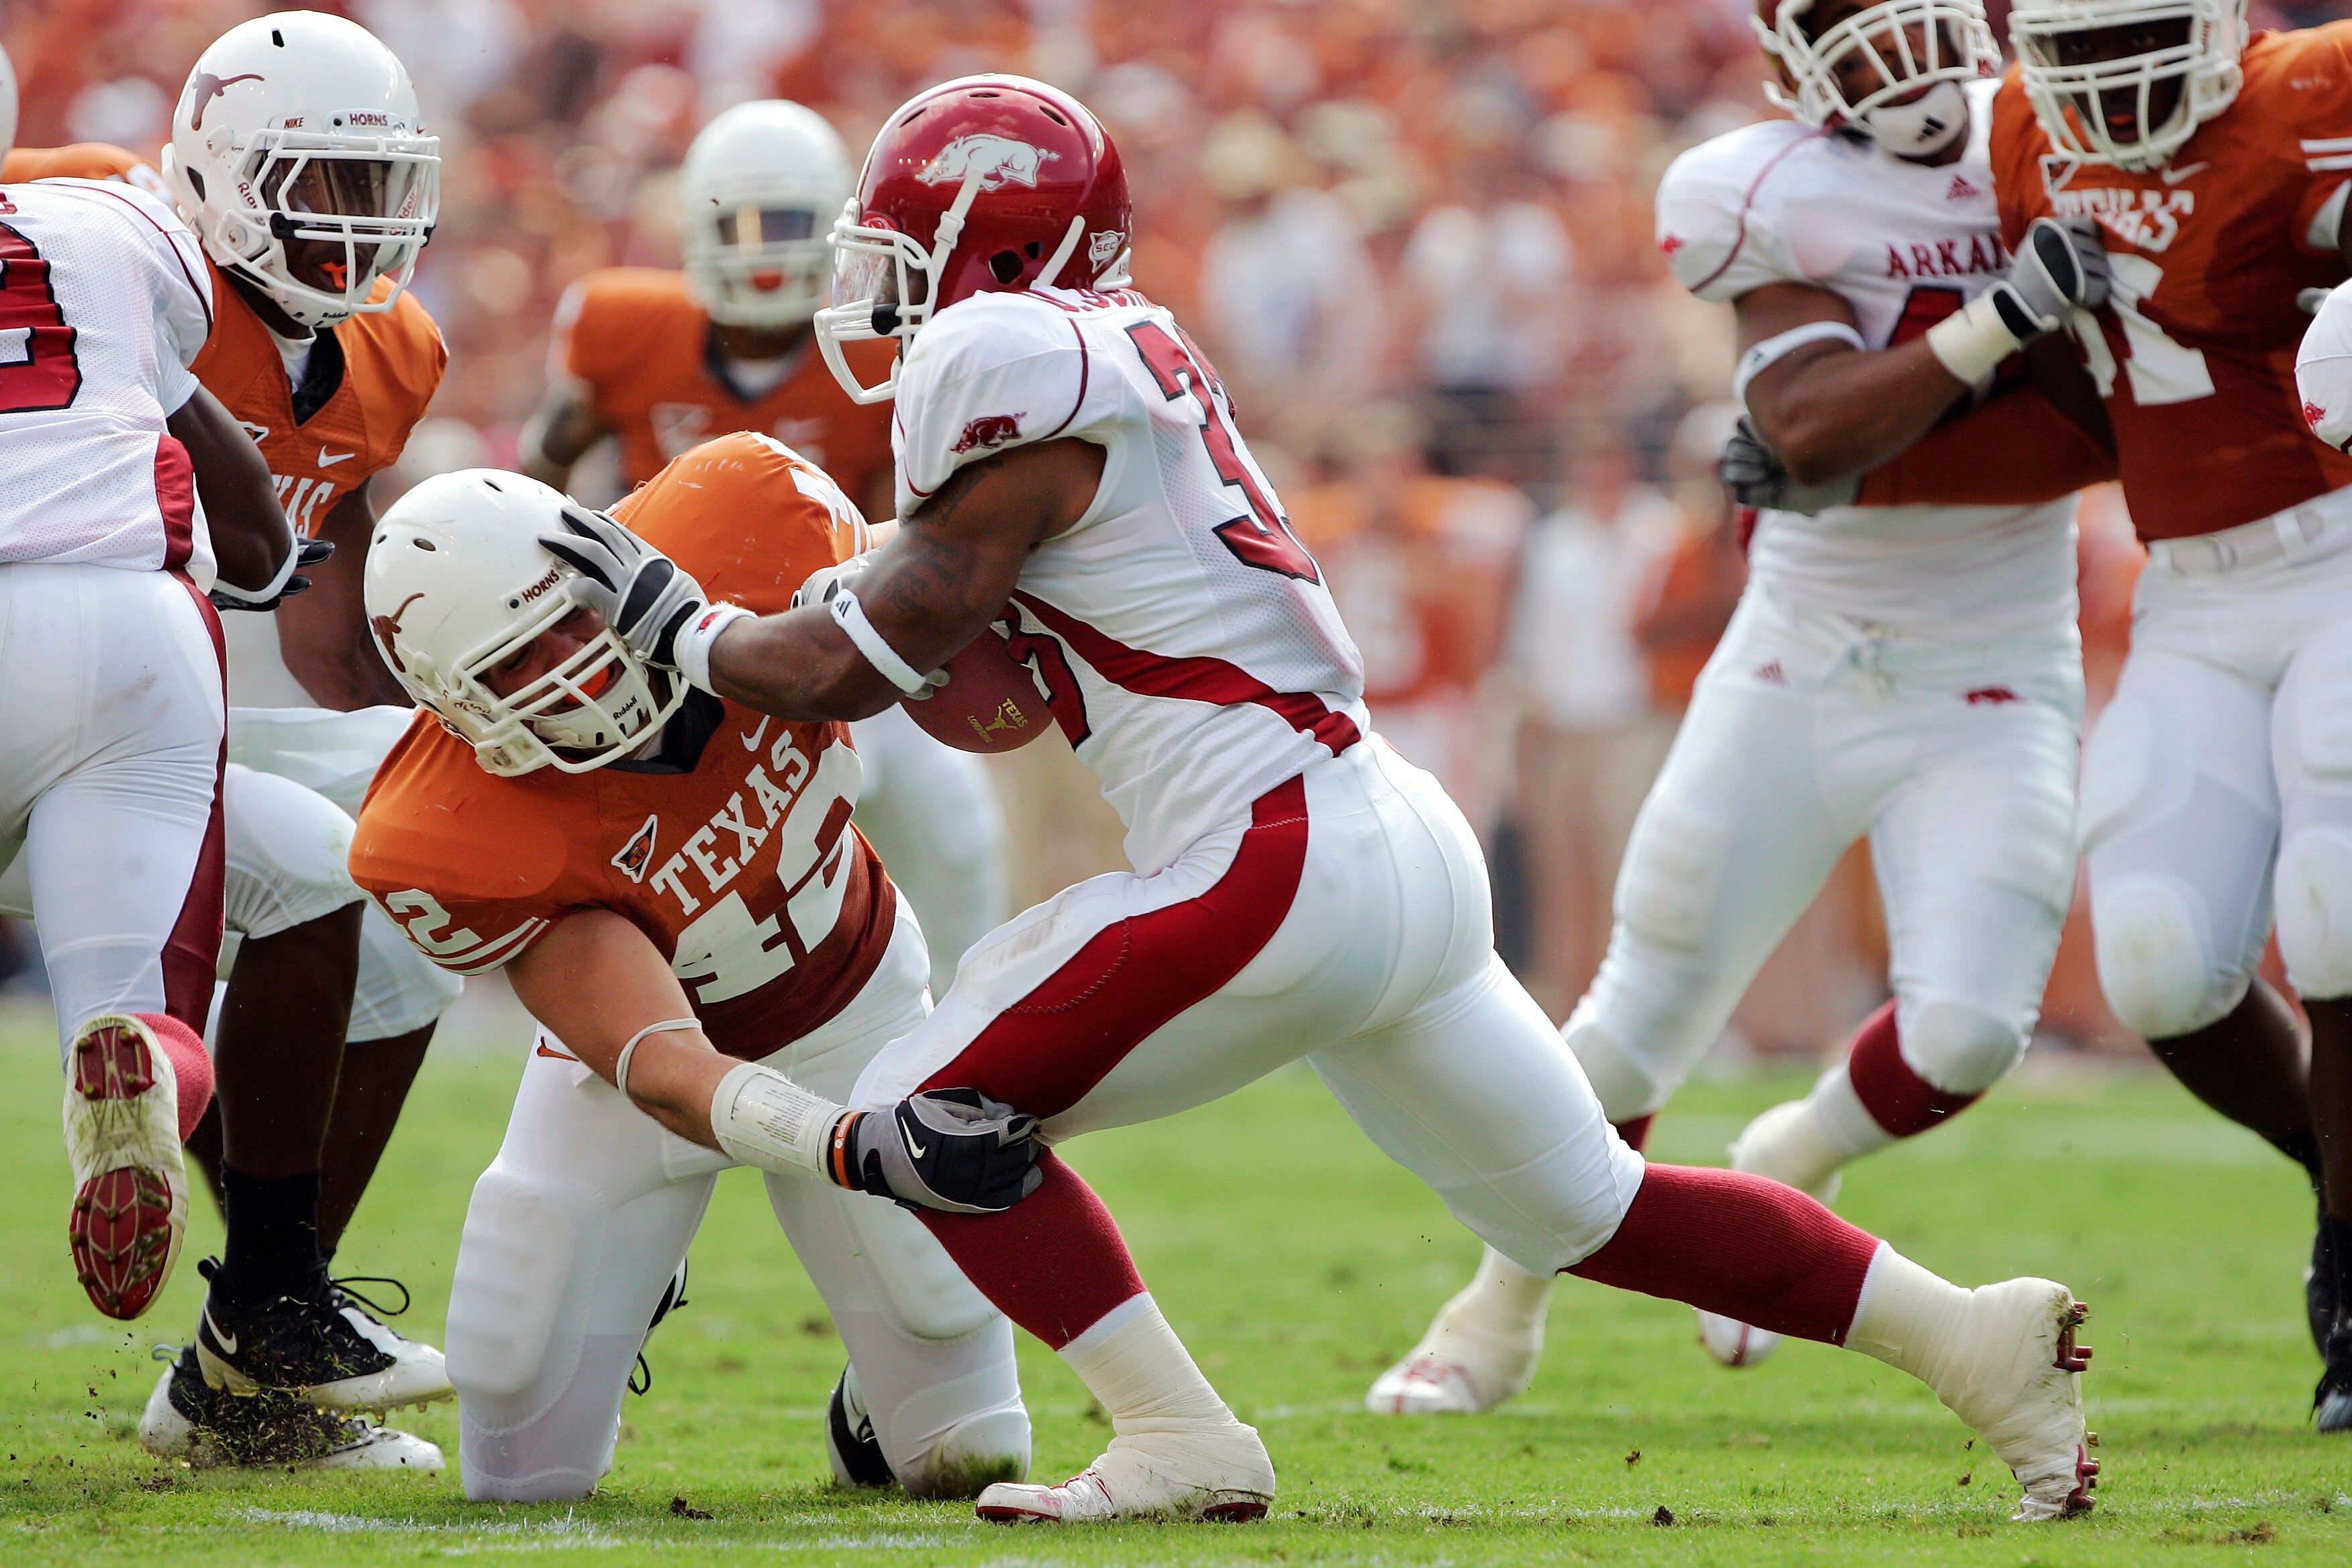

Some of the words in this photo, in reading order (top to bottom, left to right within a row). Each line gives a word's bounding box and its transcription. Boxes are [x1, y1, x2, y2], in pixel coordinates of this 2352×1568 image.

[284, 117, 304, 129] NIKE
[349, 113, 388, 127] HORNS
[1095, 241, 1117, 253] SEC
[1124, 320, 1321, 587] 3
[521, 569, 560, 603] HORNS
[613, 694, 640, 721] Riddell
[1002, 697, 1028, 728] TEXAS
[649, 729, 810, 916] TEXAS
[671, 736, 864, 1005] 42
